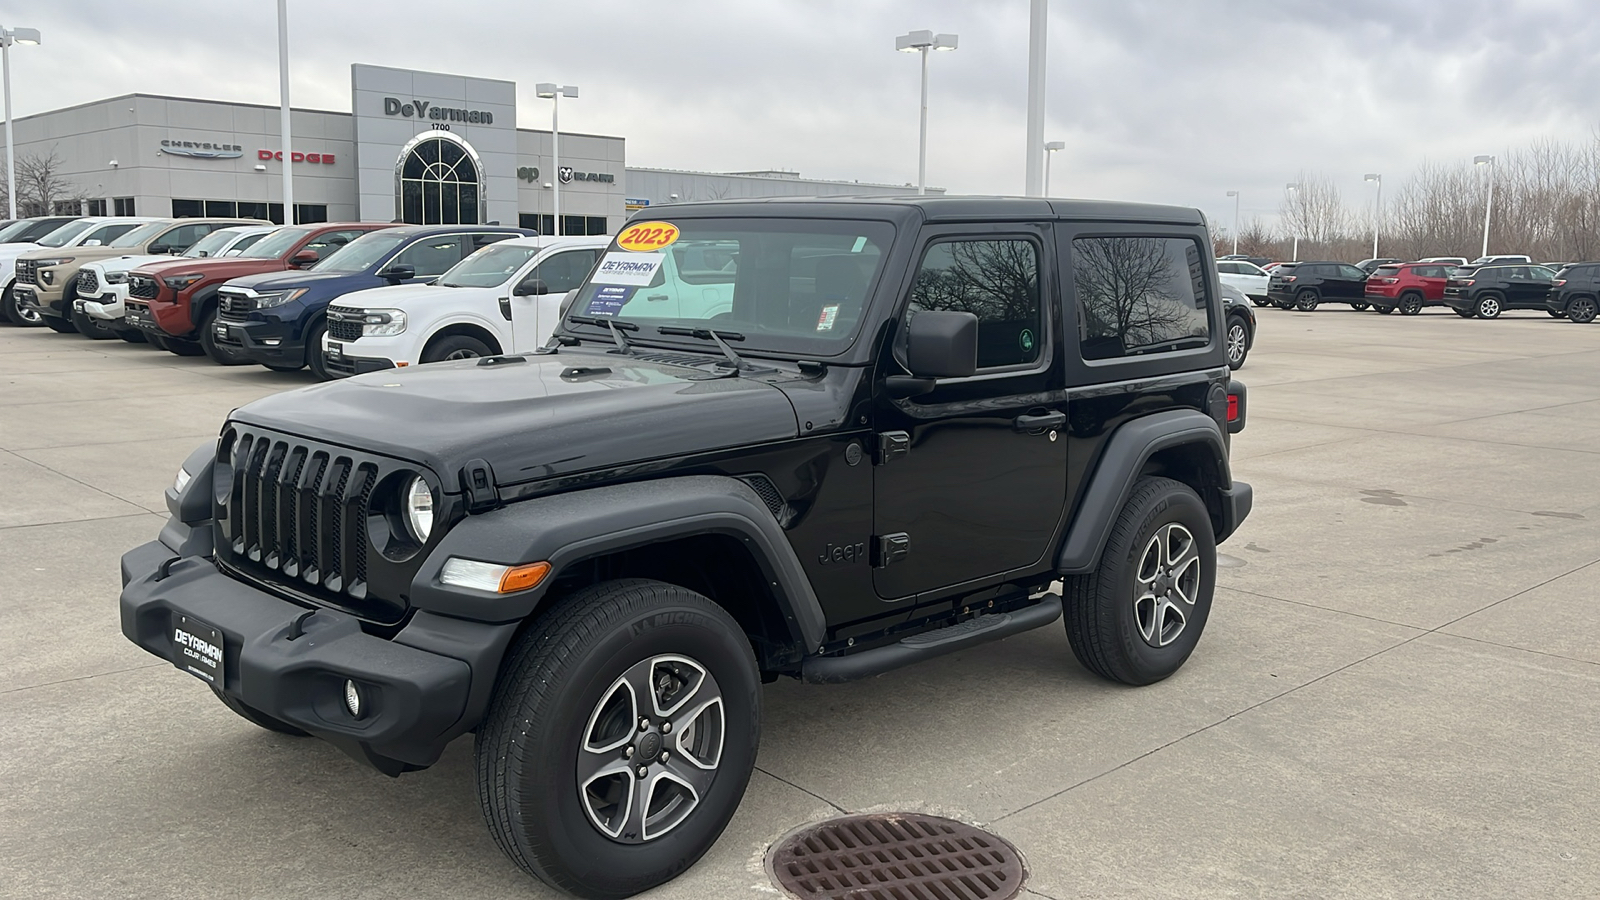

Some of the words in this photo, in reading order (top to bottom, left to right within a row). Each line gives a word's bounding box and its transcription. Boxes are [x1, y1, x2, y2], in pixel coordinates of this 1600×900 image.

[384, 97, 493, 124] DeYarman
[431, 123, 450, 131] 1700
[161, 140, 242, 151] CHRYSLER
[258, 150, 335, 164] DODGE
[574, 172, 614, 184] RAM
[621, 228, 675, 245] 2023
[602, 261, 656, 272] DEYARMAN
[818, 542, 863, 566] Jeep
[175, 629, 222, 662] DEYARMAN
[201, 656, 217, 668] AMES
